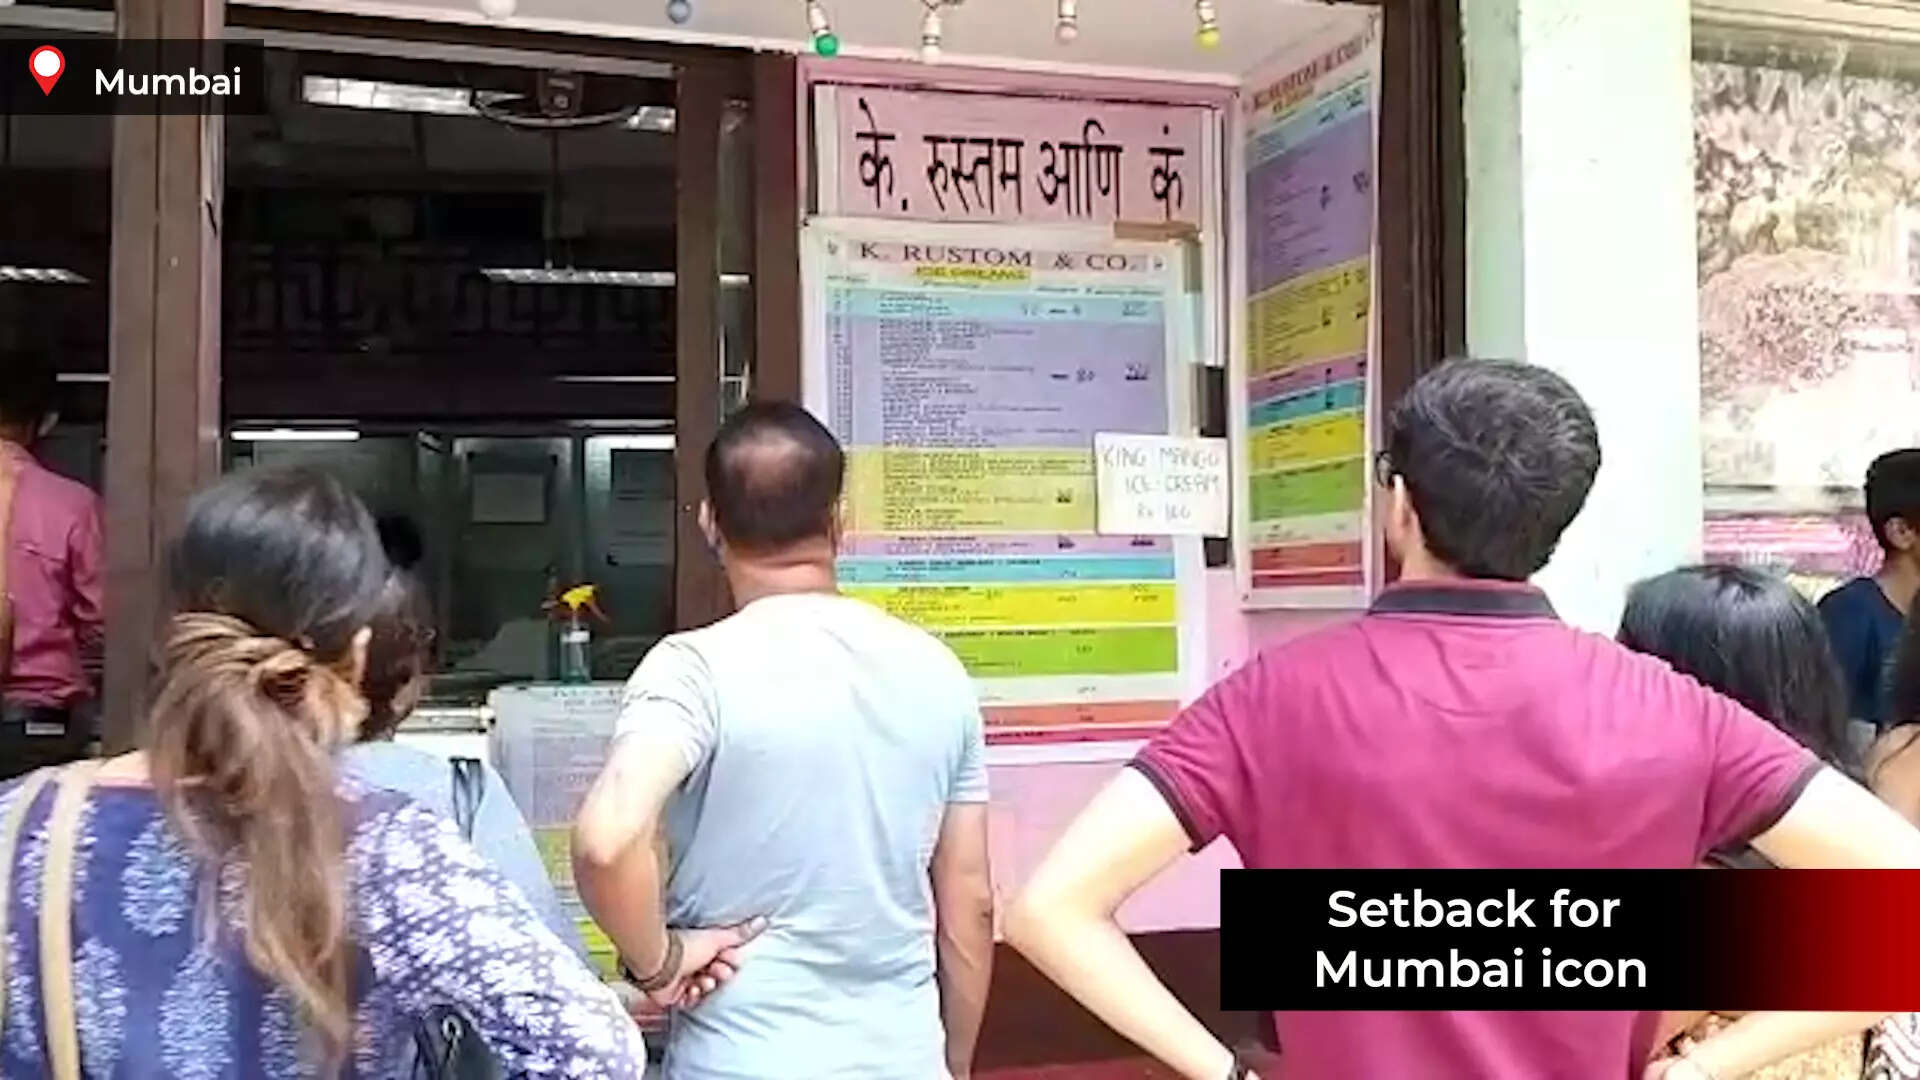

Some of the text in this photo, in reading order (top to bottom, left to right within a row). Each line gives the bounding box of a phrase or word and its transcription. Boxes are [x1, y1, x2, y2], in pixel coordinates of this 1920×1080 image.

[855, 97, 908, 211] के.
[923, 135, 1024, 214] रुस्तम
[1037, 119, 1123, 217] आणि
[1148, 125, 1184, 220] कं
[860, 242, 1138, 272] K. RUSTOM & CO.
[1101, 444, 1219, 469] KING MANGO
